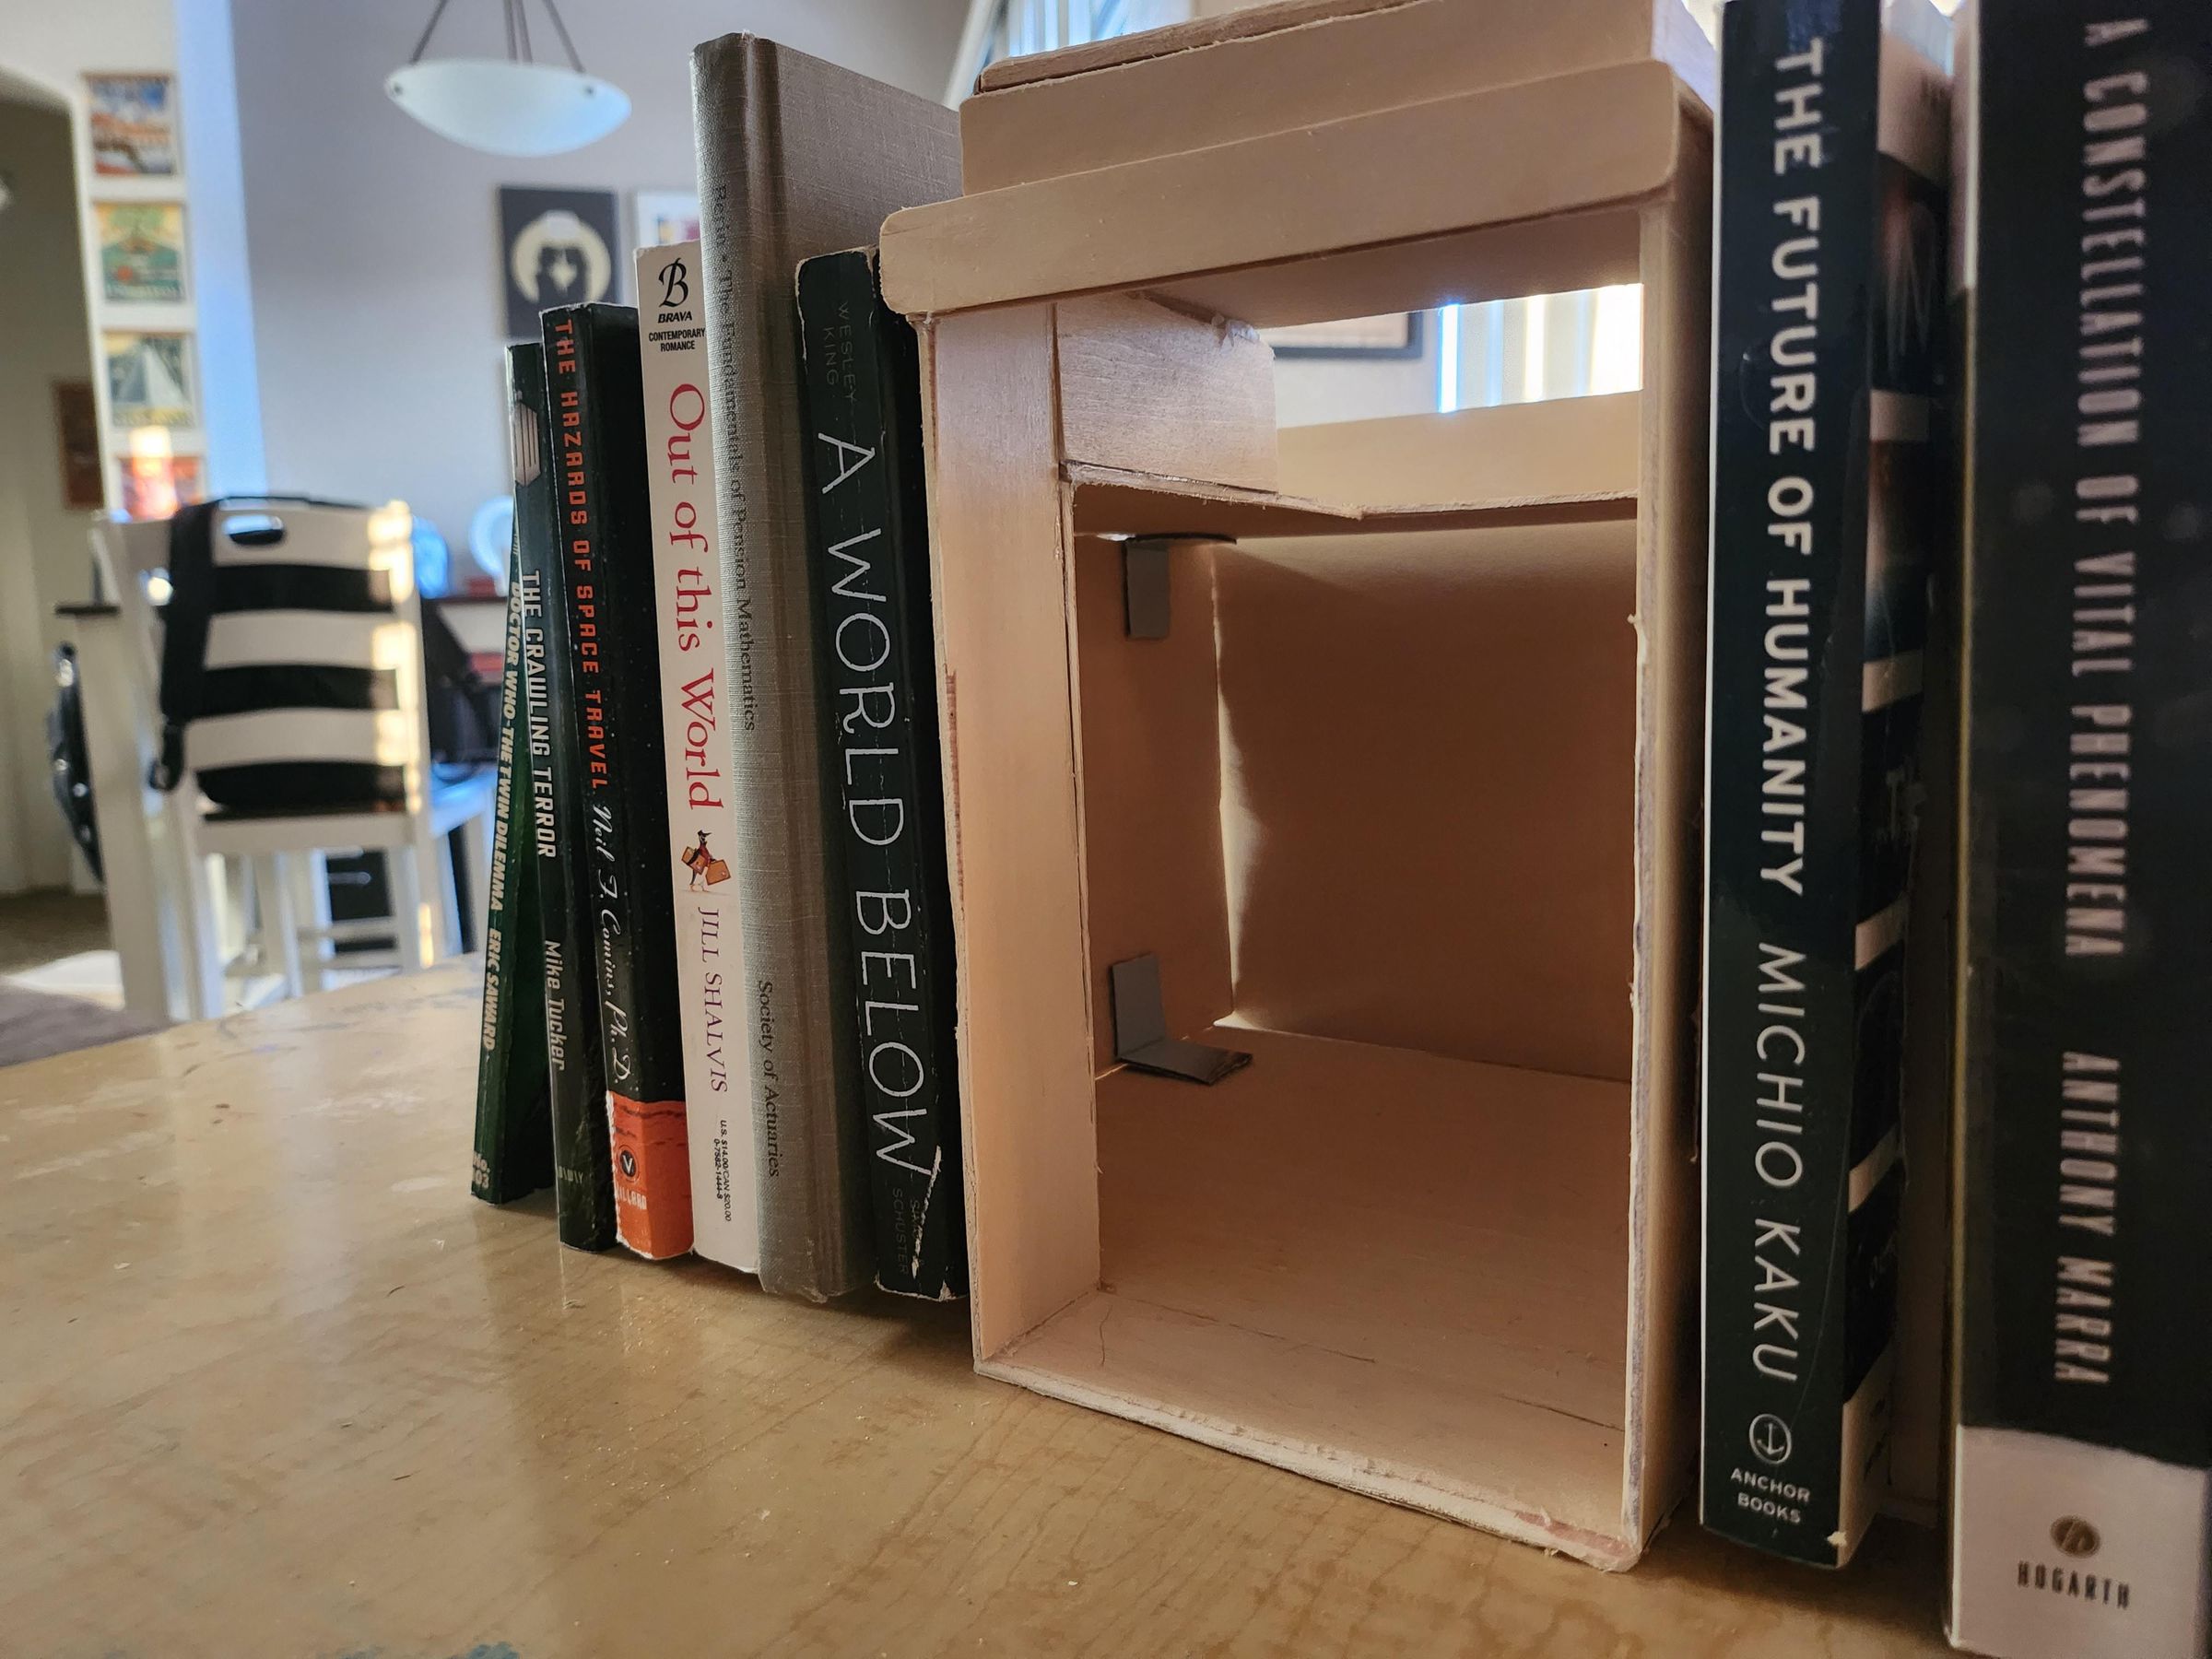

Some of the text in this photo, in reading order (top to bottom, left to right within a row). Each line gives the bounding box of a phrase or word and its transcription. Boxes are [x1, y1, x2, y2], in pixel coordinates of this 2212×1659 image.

[648, 327, 706, 342] CONTEMPORARY
[657, 311, 693, 324] BRAVA
[660, 340, 696, 352] ROMANCE
[821, 325, 840, 386] KING
[836, 301, 858, 402] WESLEY
[1759, 37, 1826, 898] THE FUTURE OF HUMANITY
[2064, 18, 2150, 958] A CONSTELLATION OF VITAL PHENOMENA
[555, 318, 608, 789] THE HAZARDS OF SPACE TRAVEL
[667, 382, 724, 809] Out of this World
[507, 581, 521, 667] DOCTOR
[736, 598, 759, 732] Mathematics
[522, 569, 557, 859] THE CRAWLING TERROR
[498, 766, 512, 819] TWIN
[818, 431, 934, 1176] A WORLD BELOW
[490, 819, 509, 912] DILEMMA
[483, 927, 502, 1051] ERIC SAWARD
[601, 909, 621, 996] Comins,
[698, 907, 729, 1094] JILL SHALVIS
[545, 940, 568, 1071] Mike Tucker
[605, 1000, 629, 1043] Ph.
[758, 980, 782, 1178] Society of Actuaries
[1752, 942, 1807, 1382] MICHIO KAKU
[891, 1186, 910, 1276] SCHUSTER
[2053, 1051, 2121, 1384] ANTHONY MARRA
[1729, 1467, 1811, 1504] ANCHOR
[1737, 1492, 1802, 1524] BOOKS
[2016, 1559, 2132, 1610] HOGARTH
